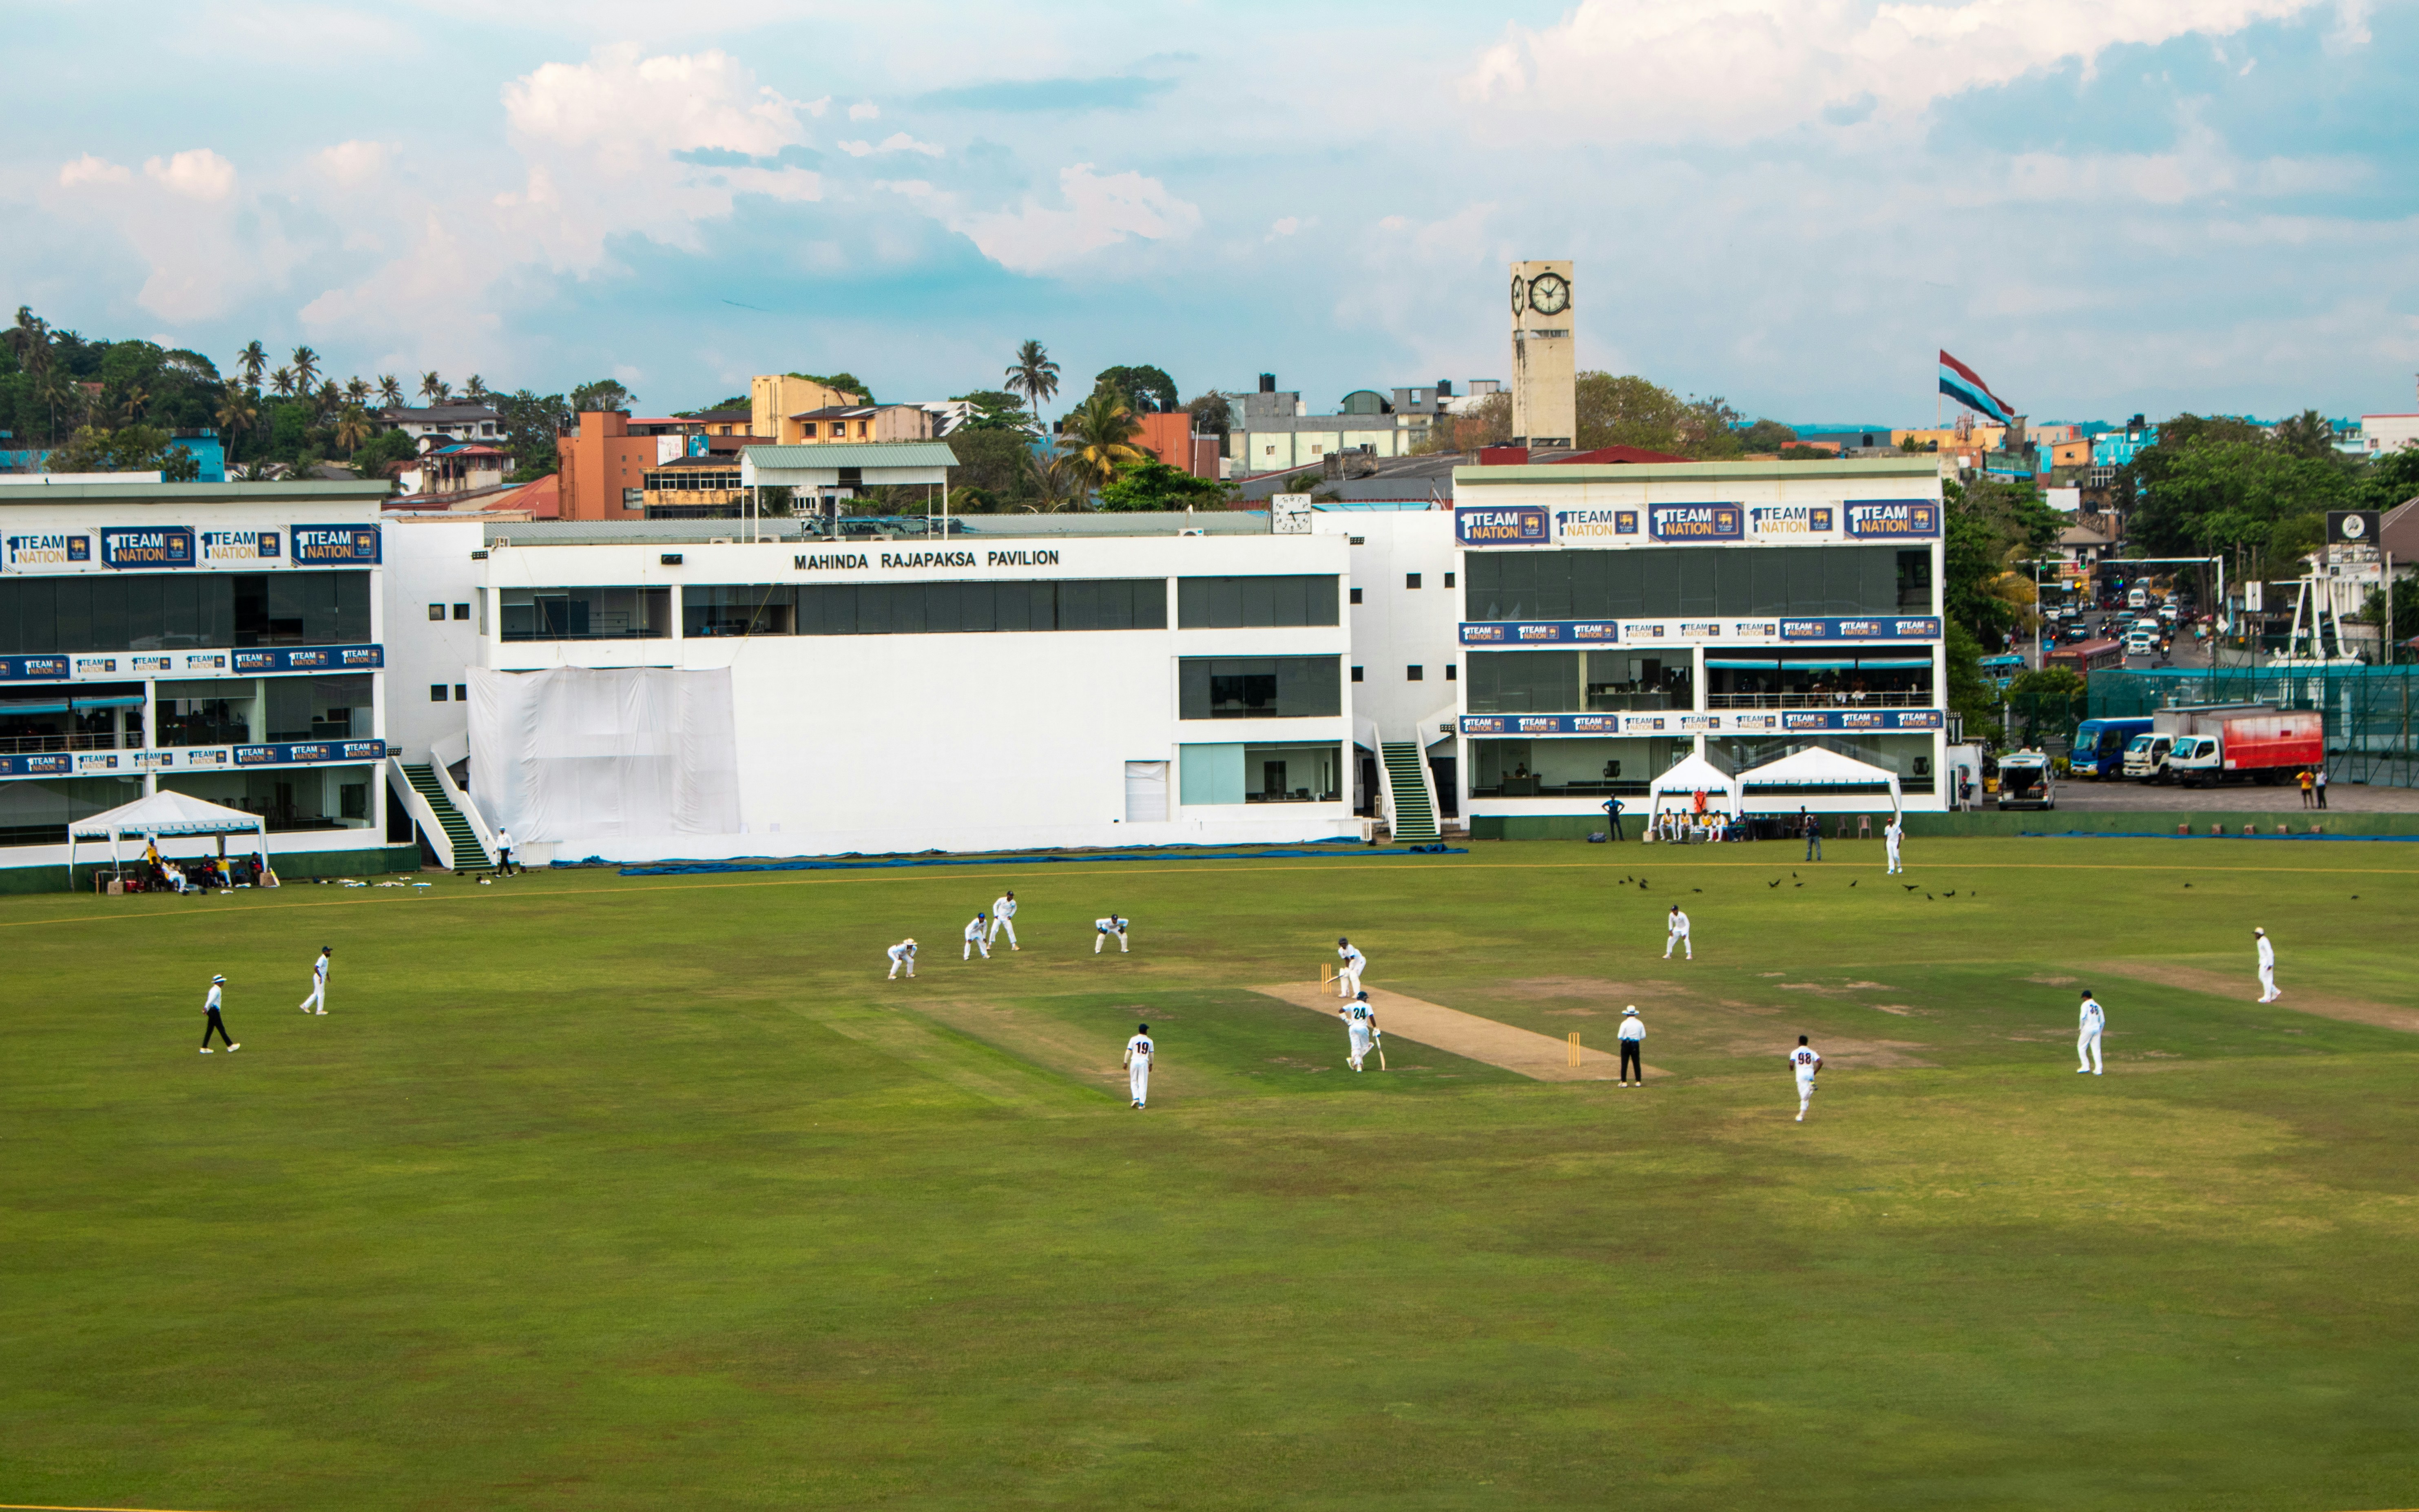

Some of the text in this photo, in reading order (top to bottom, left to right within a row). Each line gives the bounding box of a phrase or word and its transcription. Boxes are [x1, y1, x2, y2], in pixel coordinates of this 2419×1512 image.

[1474, 512, 1518, 526] TEAM
[1568, 511, 1611, 523] TEAM
[1667, 508, 1712, 522] TEAM
[1763, 507, 1806, 520] TEAM
[1863, 505, 1908, 520] TEAM
[1473, 526, 1518, 539] NATION
[1567, 525, 1612, 536] NATION
[1666, 522, 1712, 535] NATION
[1762, 521, 1807, 533] NATION
[1861, 520, 1908, 533] NATION
[20, 535, 64, 549] TEAM
[120, 533, 163, 547] TEAM
[213, 531, 255, 545] TEAM
[309, 531, 351, 545] TEAM
[18, 551, 64, 563] NATION
[118, 548, 164, 561] NATION
[211, 547, 256, 559] NATION
[307, 545, 351, 558] NATION
[795, 551, 1058, 569] MAHINDA RAJAPAKSA PAVILION
[1354, 1007, 1366, 1019] 24
[1136, 1042, 1149, 1054] 19
[1798, 1052, 1811, 1065] 98
